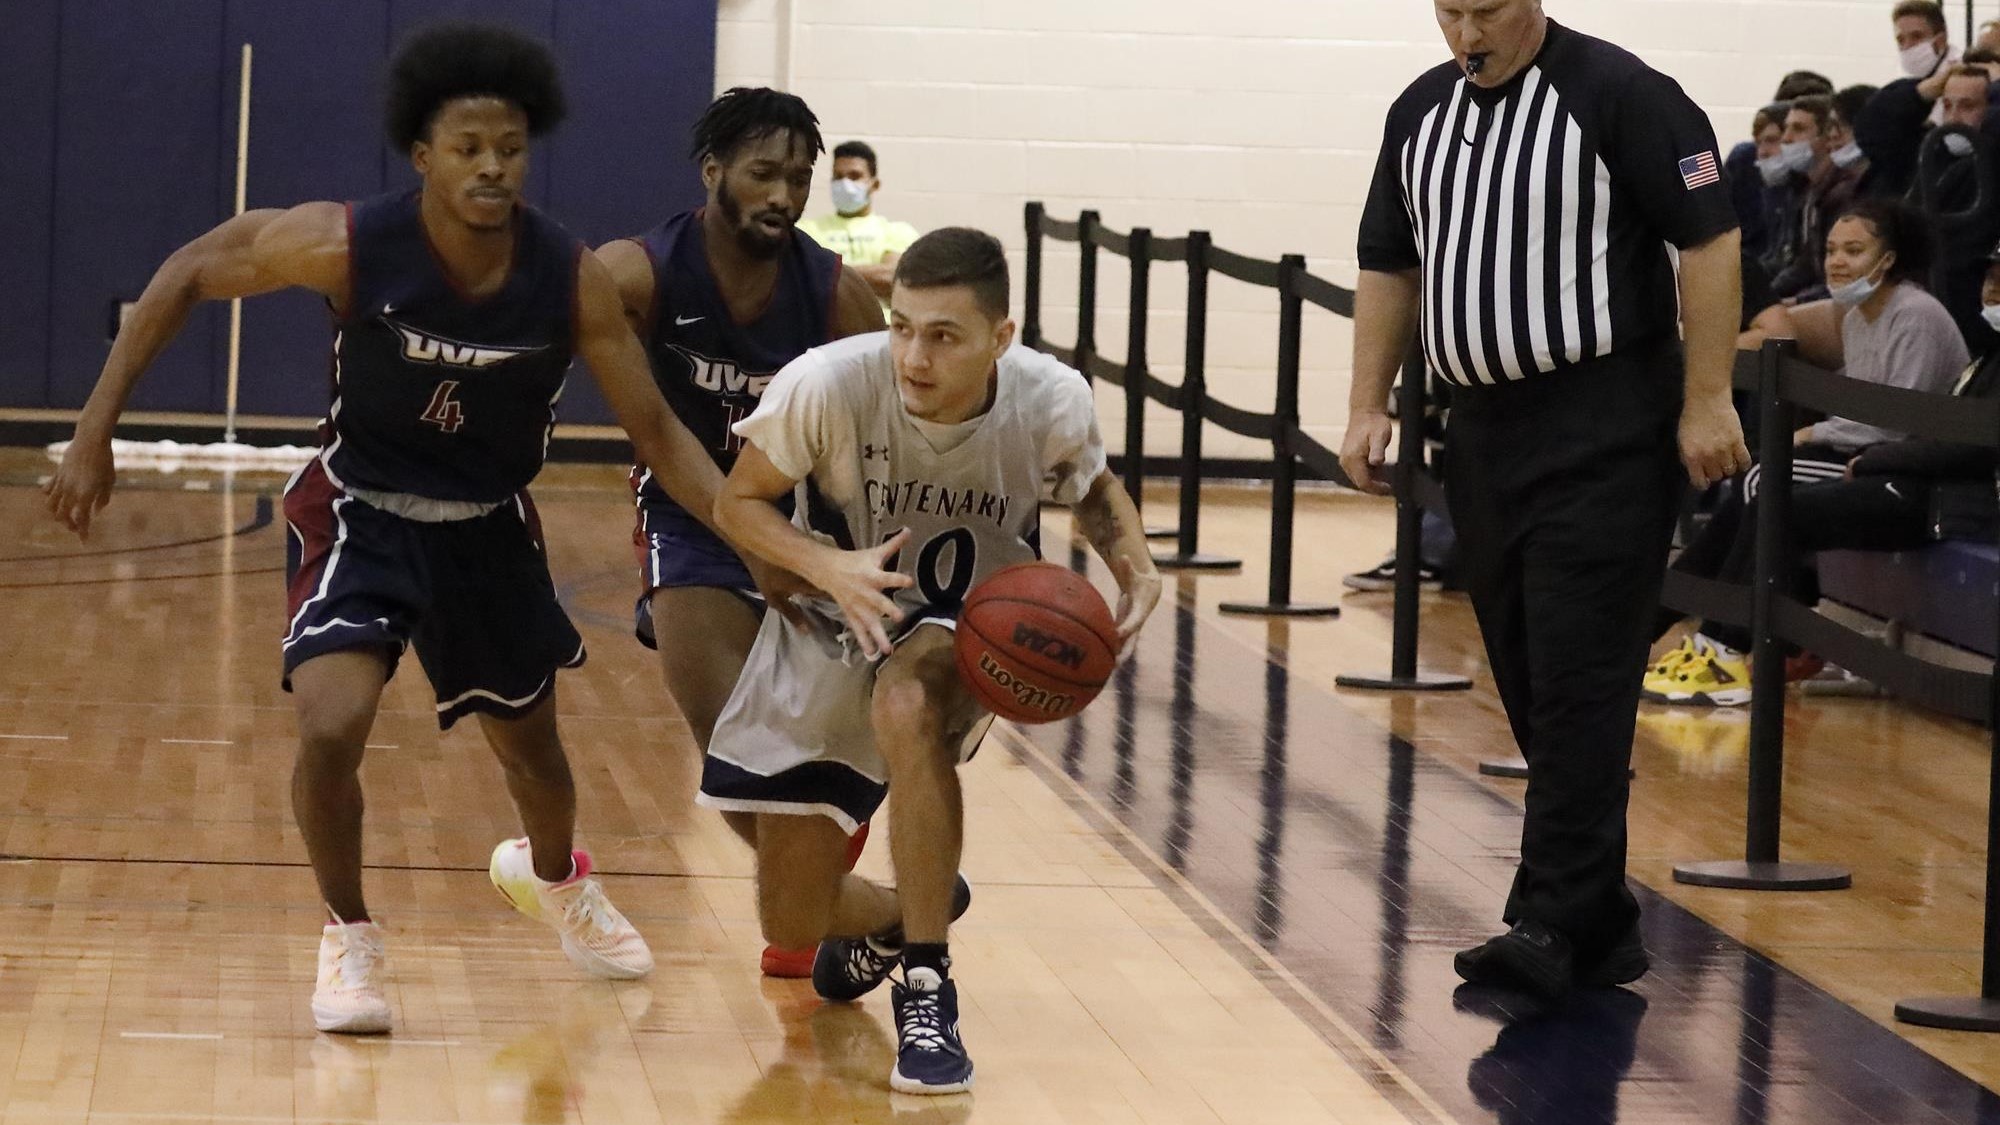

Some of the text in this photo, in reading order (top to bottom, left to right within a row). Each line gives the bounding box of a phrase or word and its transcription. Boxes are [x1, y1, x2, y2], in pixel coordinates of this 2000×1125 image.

[400, 328, 521, 367] UVF
[420, 379, 464, 433] 4
[865, 478, 1010, 527] CNTENARY
[1012, 621, 1087, 669] NCAA
[978, 651, 1077, 713] Wilson
